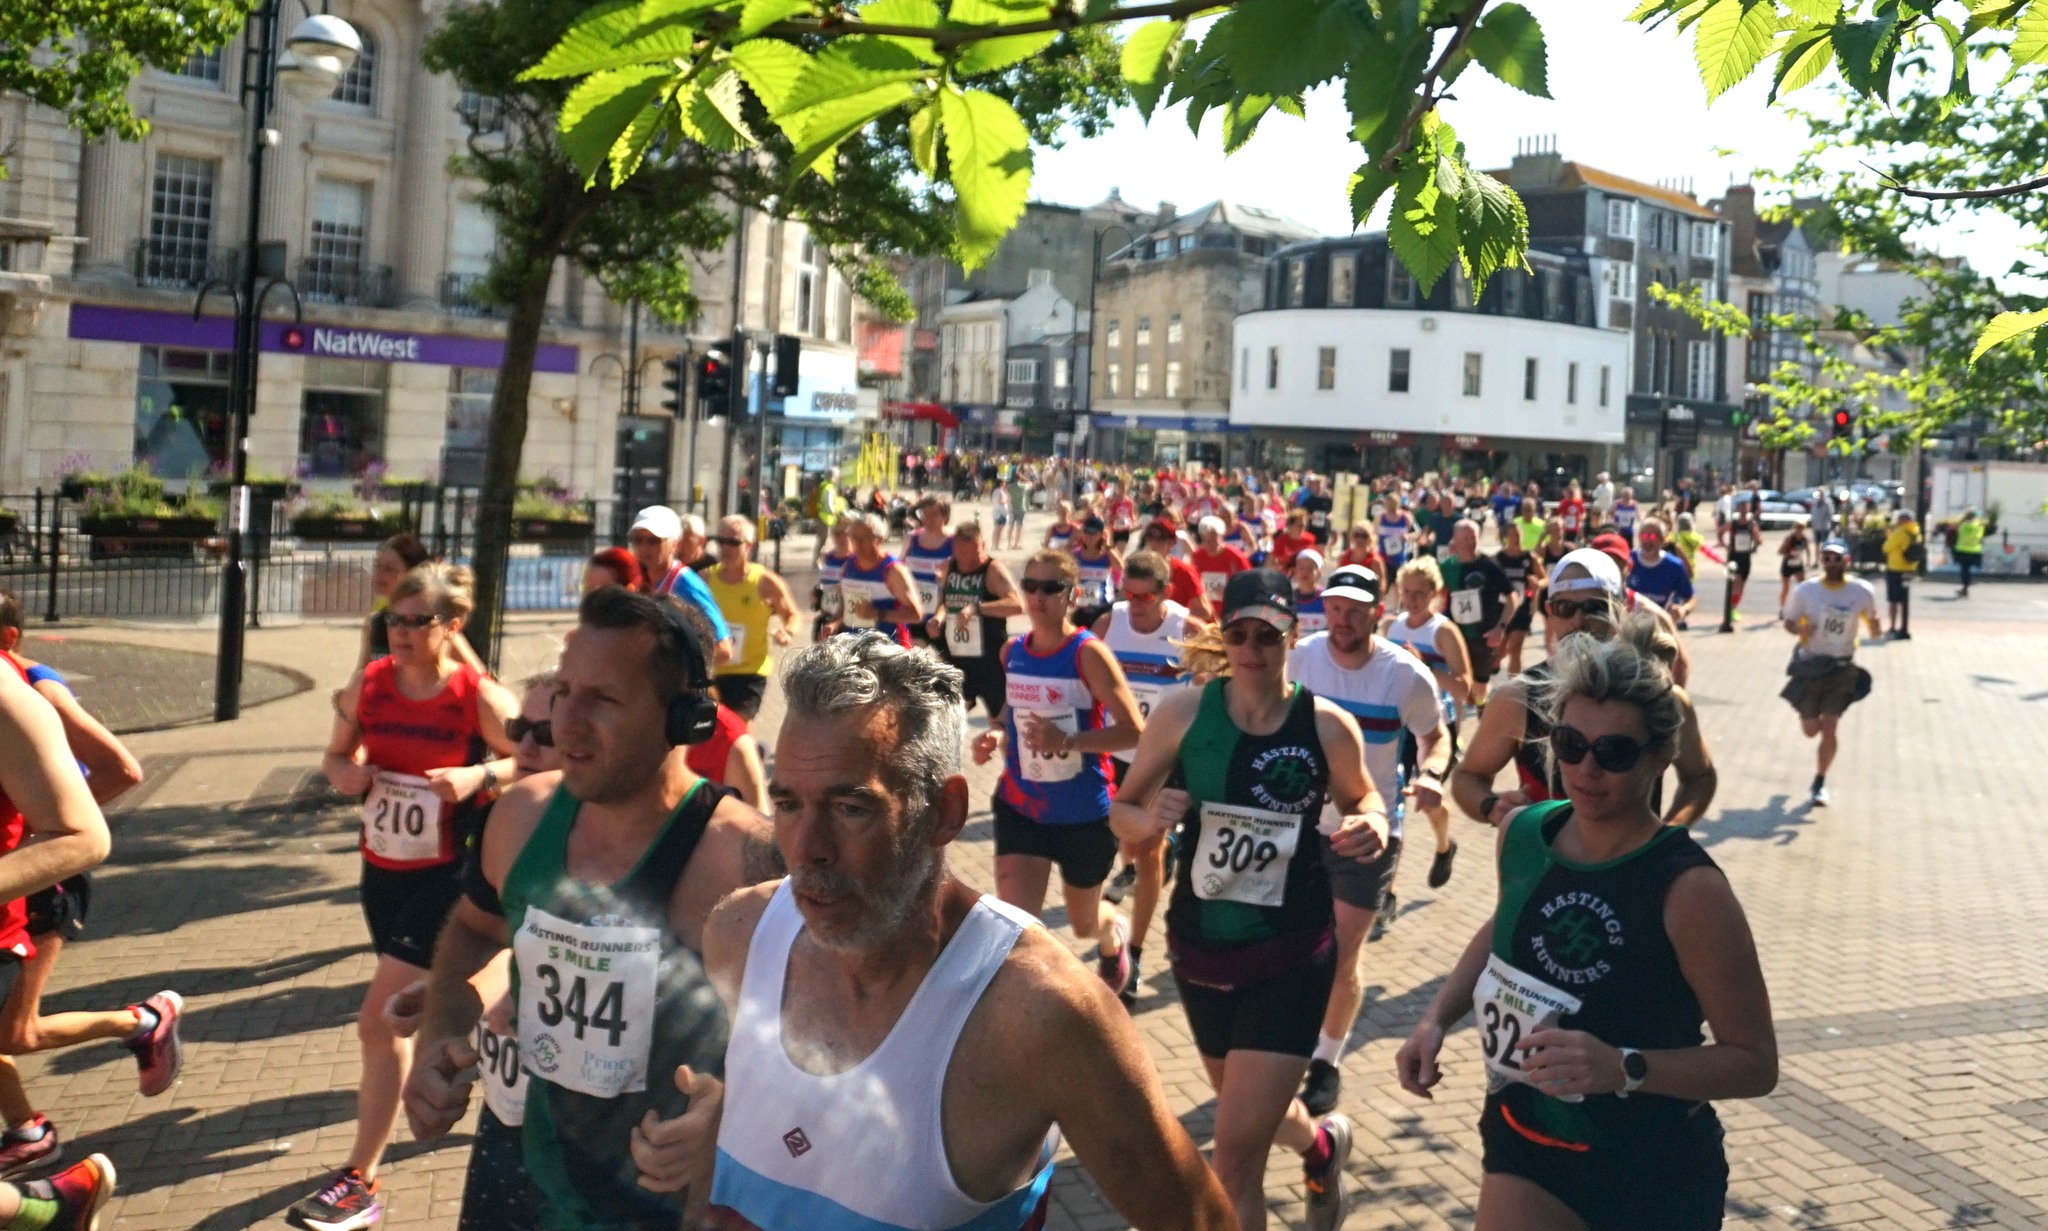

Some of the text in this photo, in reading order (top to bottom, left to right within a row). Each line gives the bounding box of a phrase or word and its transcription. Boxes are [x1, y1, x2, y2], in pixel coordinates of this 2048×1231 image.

[313, 327, 418, 359] NatWest
[953, 627, 970, 643] 80
[1251, 746, 1319, 776] HASTINGS
[1251, 783, 1318, 814] RUNNERS
[374, 797, 424, 837] 210
[1208, 827, 1278, 874] 309
[1540, 892, 1624, 947] HASTINGS
[527, 923, 651, 953] HASTINGS RUNNERS
[548, 945, 611, 972] 5 MILE
[1531, 934, 1612, 985] RUNNERS
[1487, 967, 1518, 991] HASTINGS
[536, 963, 627, 1047] 344
[1503, 992, 1537, 1018] MILE
[1482, 1001, 1545, 1069] 32
